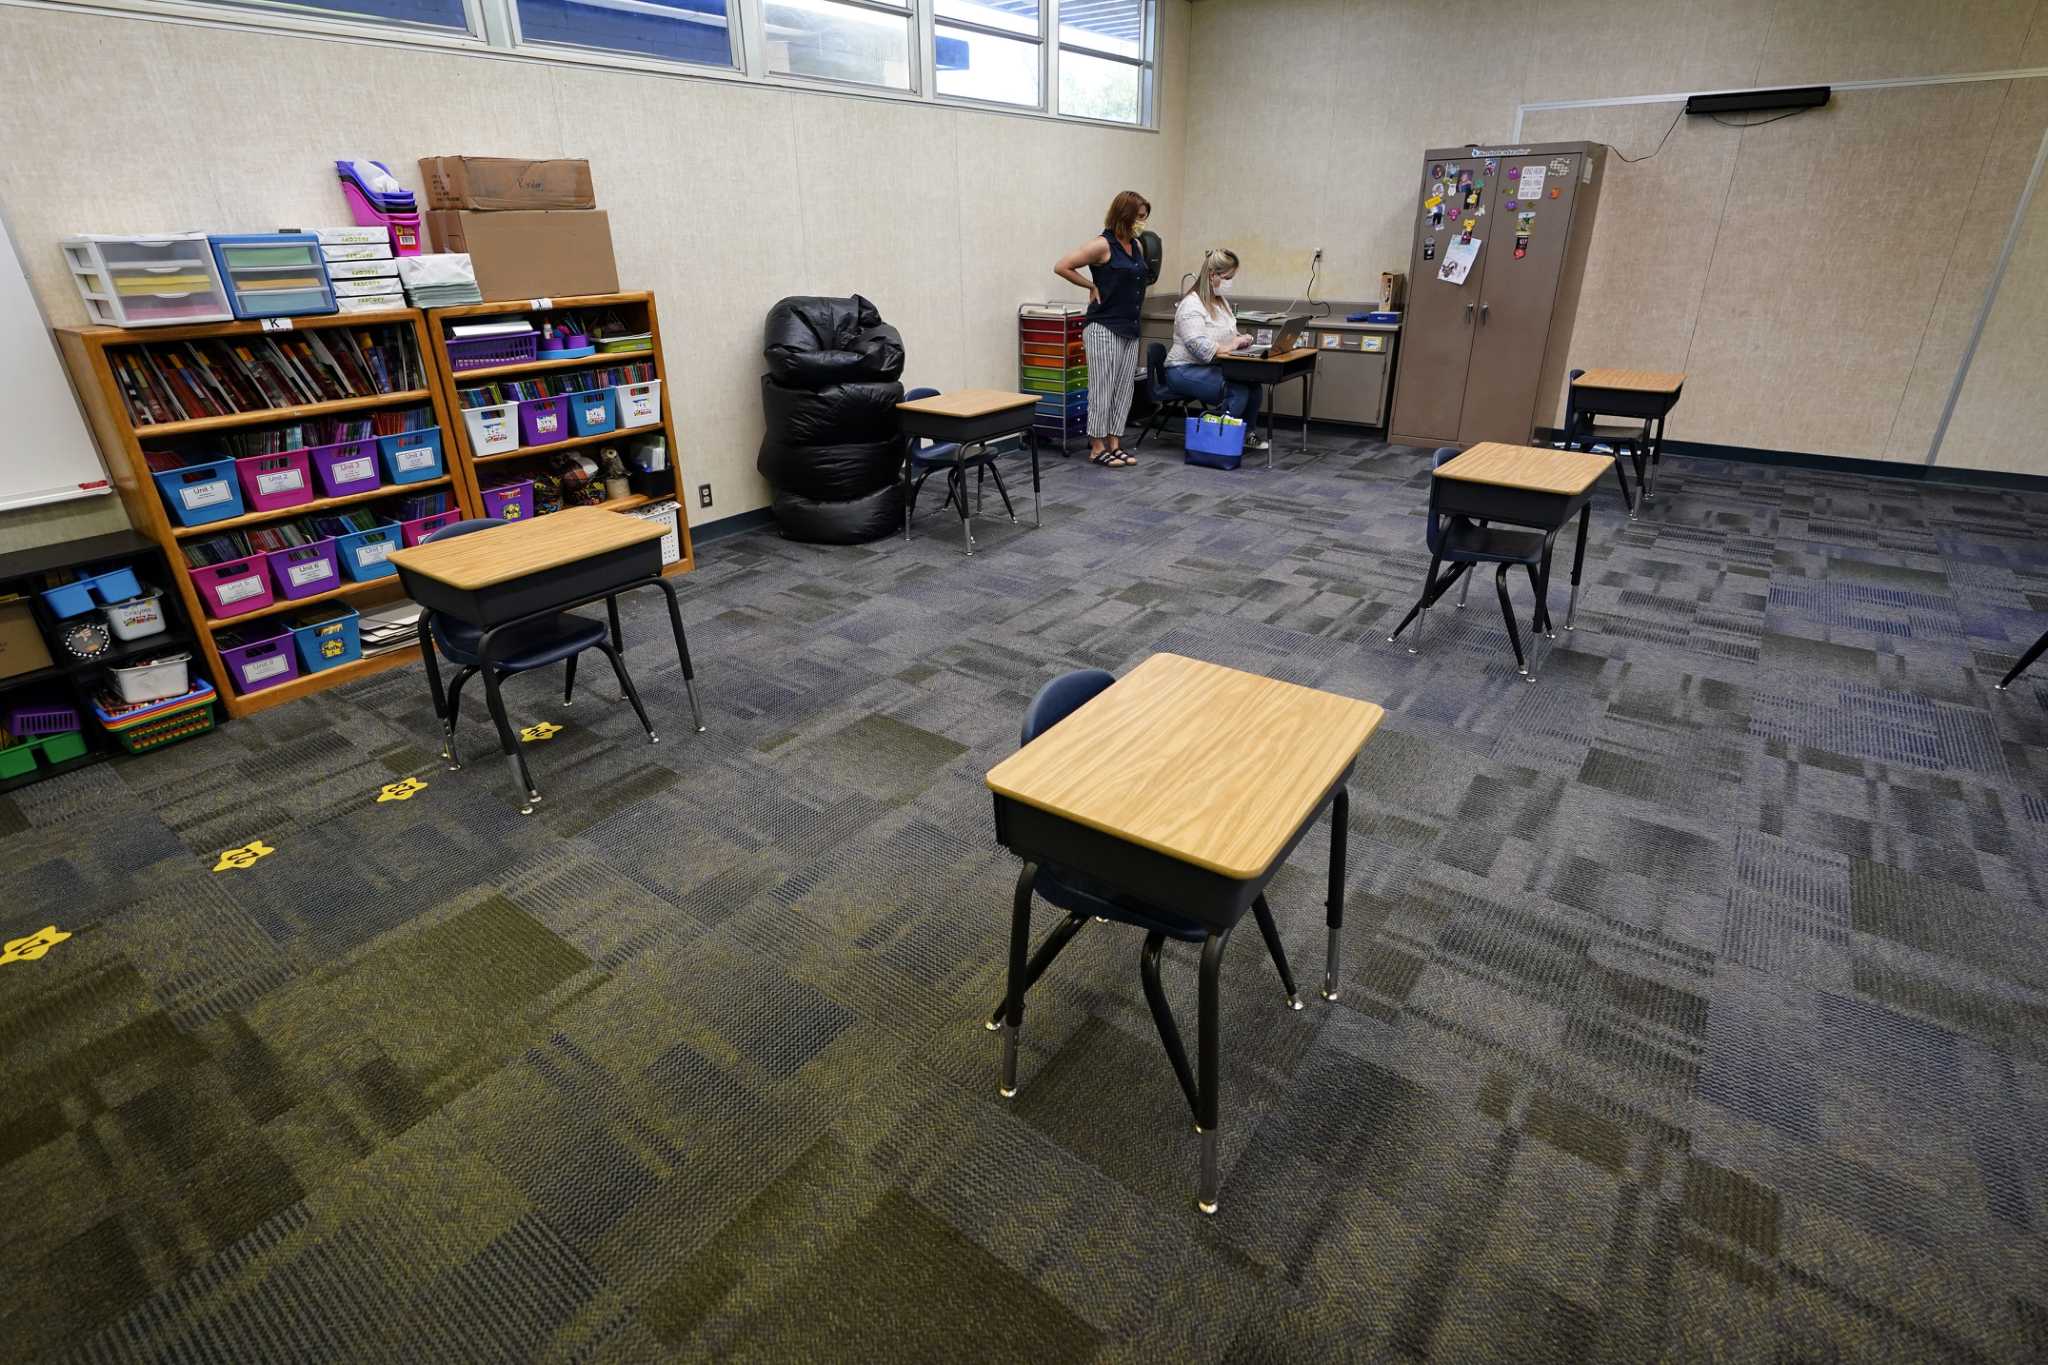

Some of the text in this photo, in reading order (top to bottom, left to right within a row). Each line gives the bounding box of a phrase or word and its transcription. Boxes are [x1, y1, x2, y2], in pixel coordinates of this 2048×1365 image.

[269, 318, 280, 328] K
[340, 462, 355, 471] Unit
[193, 486, 209, 495] Unit
[299, 564, 314, 573] Unit
[526, 726, 553, 737] 24
[388, 782, 415, 796] 23
[227, 848, 259, 865] 22
[9, 936, 50, 956] 21
